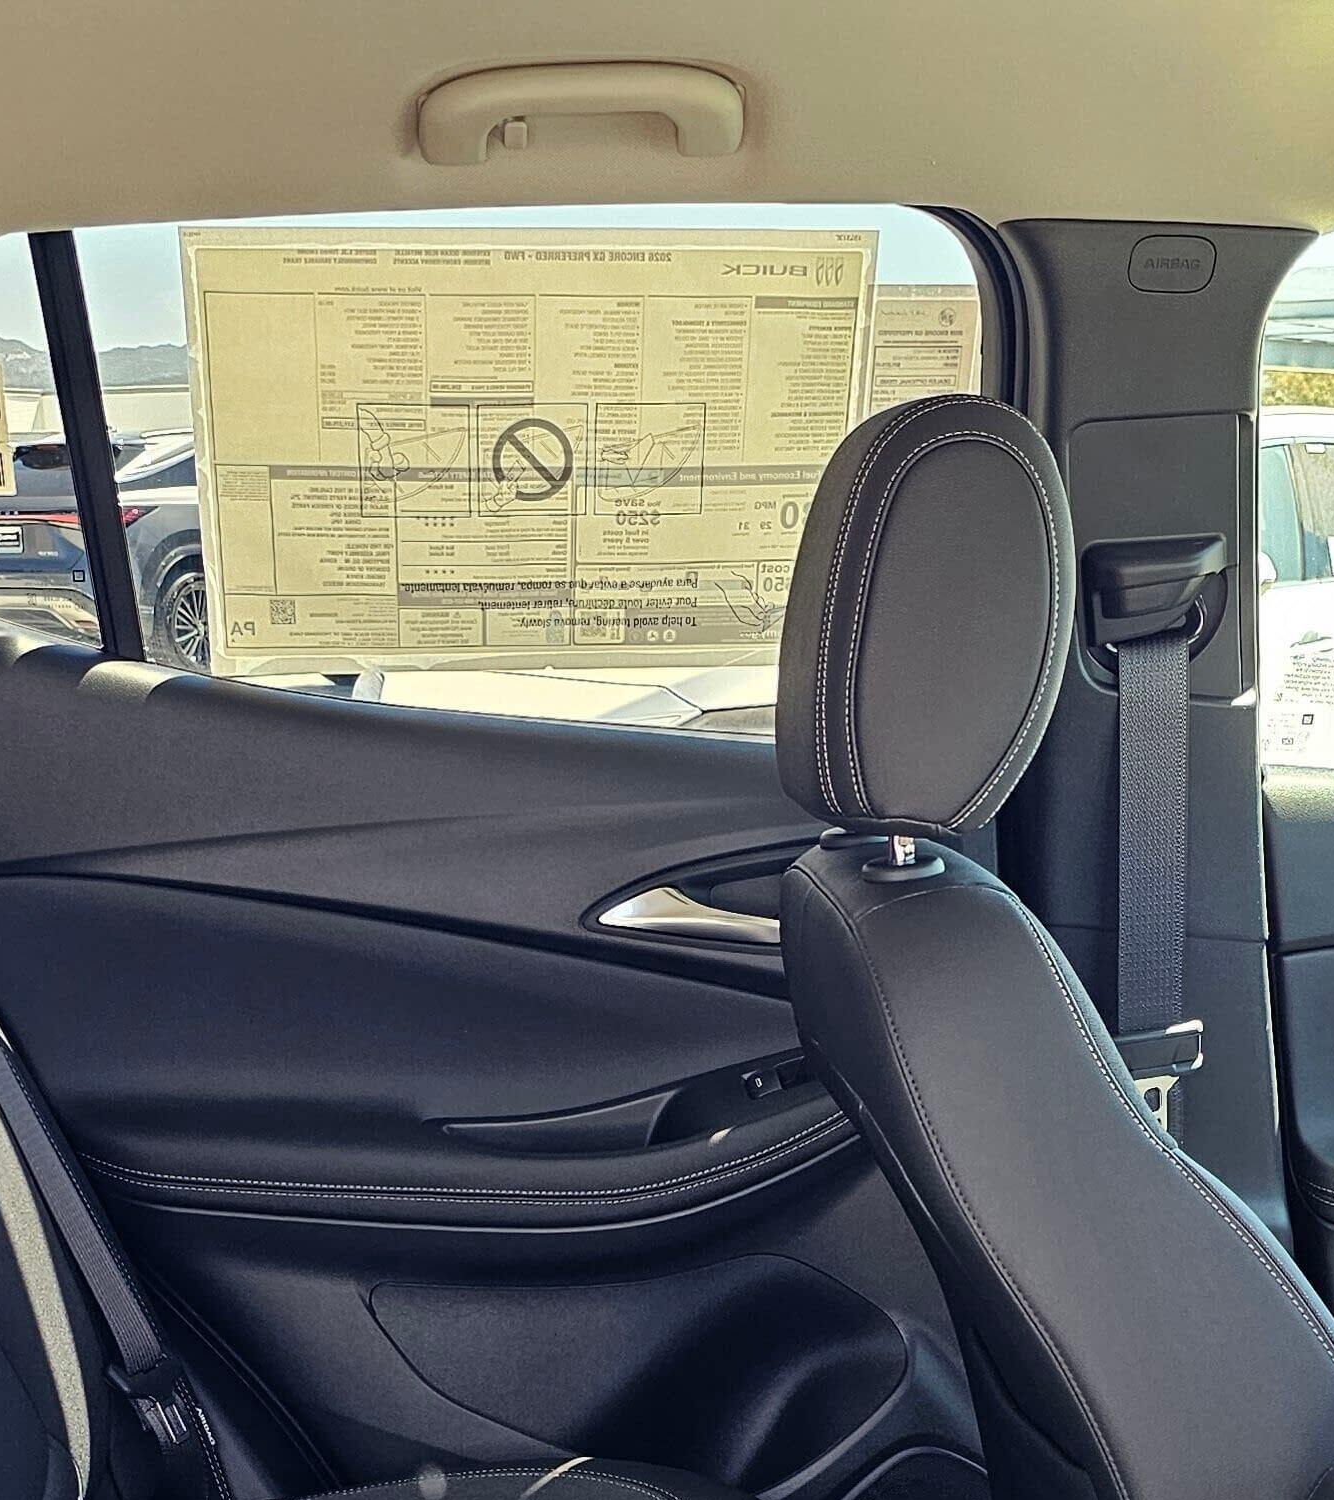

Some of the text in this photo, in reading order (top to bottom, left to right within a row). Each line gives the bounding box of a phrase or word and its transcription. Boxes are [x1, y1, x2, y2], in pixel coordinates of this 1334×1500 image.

[1144, 257, 1201, 270] AIRBAG
[401, 583, 460, 593] lentamente.
[517, 580, 552, 590] rompa,
[554, 581, 566, 589] se
[676, 578, 698, 589] Para
[478, 600, 530, 611] lentement.
[676, 597, 697, 607] Pour
[517, 617, 552, 628] slowly.
[554, 617, 590, 627] remove
[633, 617, 659, 627] avoid
[661, 615, 682, 627] help
[685, 616, 697, 627] To
